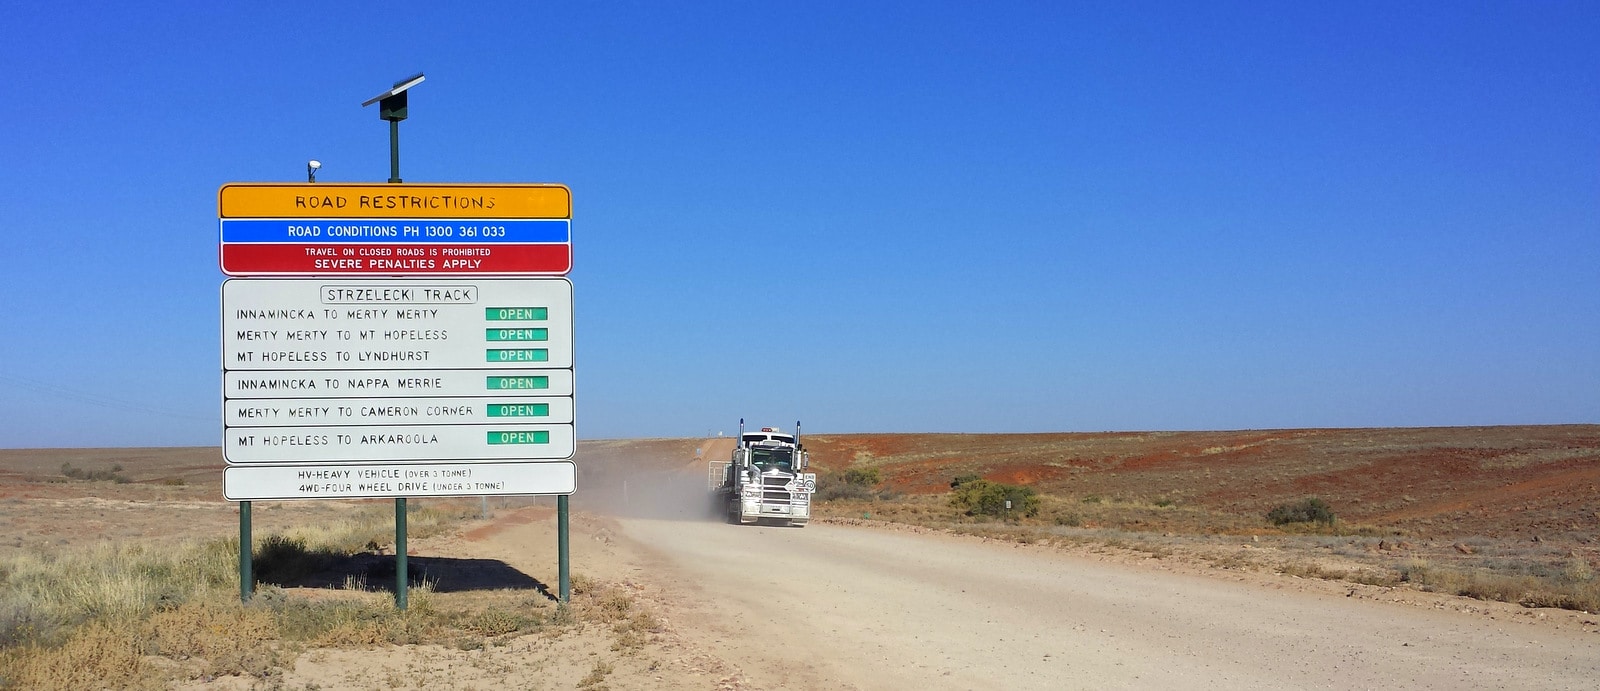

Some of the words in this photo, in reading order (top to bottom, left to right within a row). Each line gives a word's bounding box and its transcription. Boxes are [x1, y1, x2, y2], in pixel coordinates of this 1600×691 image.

[296, 196, 346, 208] ROAD
[360, 195, 495, 208] RESTRICTIONS
[288, 226, 320, 236] ROAD
[328, 226, 397, 236] CONDITIONS
[404, 226, 419, 236] PH
[426, 226, 452, 236] 1300
[459, 226, 477, 236] 361
[483, 226, 505, 236] 033
[305, 248, 337, 256] TRAVEL
[315, 260, 362, 268] SEVERE
[370, 260, 435, 268] PENALTIES
[443, 260, 481, 268] APPLY
[328, 289, 413, 300] STRZELECKI
[424, 290, 470, 300] TRACK
[237, 310, 314, 319] INNAMINCKA
[324, 310, 337, 319] TO
[347, 310, 387, 319] MERTY
[397, 310, 437, 319] MERTY
[499, 309, 532, 319] OPEN
[238, 331, 277, 340] MERTY
[287, 331, 327, 340] MERTY
[337, 331, 350, 340] TO
[360, 331, 375, 339] MT
[385, 330, 447, 340] HOPELESS
[499, 330, 533, 339] OPEN
[238, 352, 253, 361] MT
[263, 352, 326, 361] HOPELESS
[336, 352, 350, 361] TO
[359, 351, 429, 361] LYNDHURST
[499, 351, 533, 360] OPEN
[239, 380, 315, 389] INNAMINCKA
[325, 379, 339, 388] TO
[349, 379, 389, 388] NAPPA
[398, 378, 441, 388] MERRIE
[500, 378, 533, 389] OPEN
[239, 408, 279, 417] MERTY
[289, 408, 329, 417] MERTY
[338, 407, 352, 416] TO
[361, 407, 417, 416] CAMERON
[427, 406, 472, 415] CORNER
[501, 406, 534, 415] OPEN
[239, 436, 254, 446] MT
[264, 436, 328, 445] HOPELESS
[337, 435, 351, 444] TO
[361, 434, 437, 444] ARKAROOLA
[501, 433, 534, 443] OPEN
[299, 471, 350, 479] HV-HEAVY
[358, 470, 399, 478] VEHICLE
[442, 470, 471, 478] TONNE)
[299, 484, 351, 492] 4WD-FOUR
[359, 483, 391, 491] WHEEL
[399, 482, 427, 491] DRIVE
[432, 482, 463, 491] (UNDER
[475, 482, 505, 491] TONNE)
